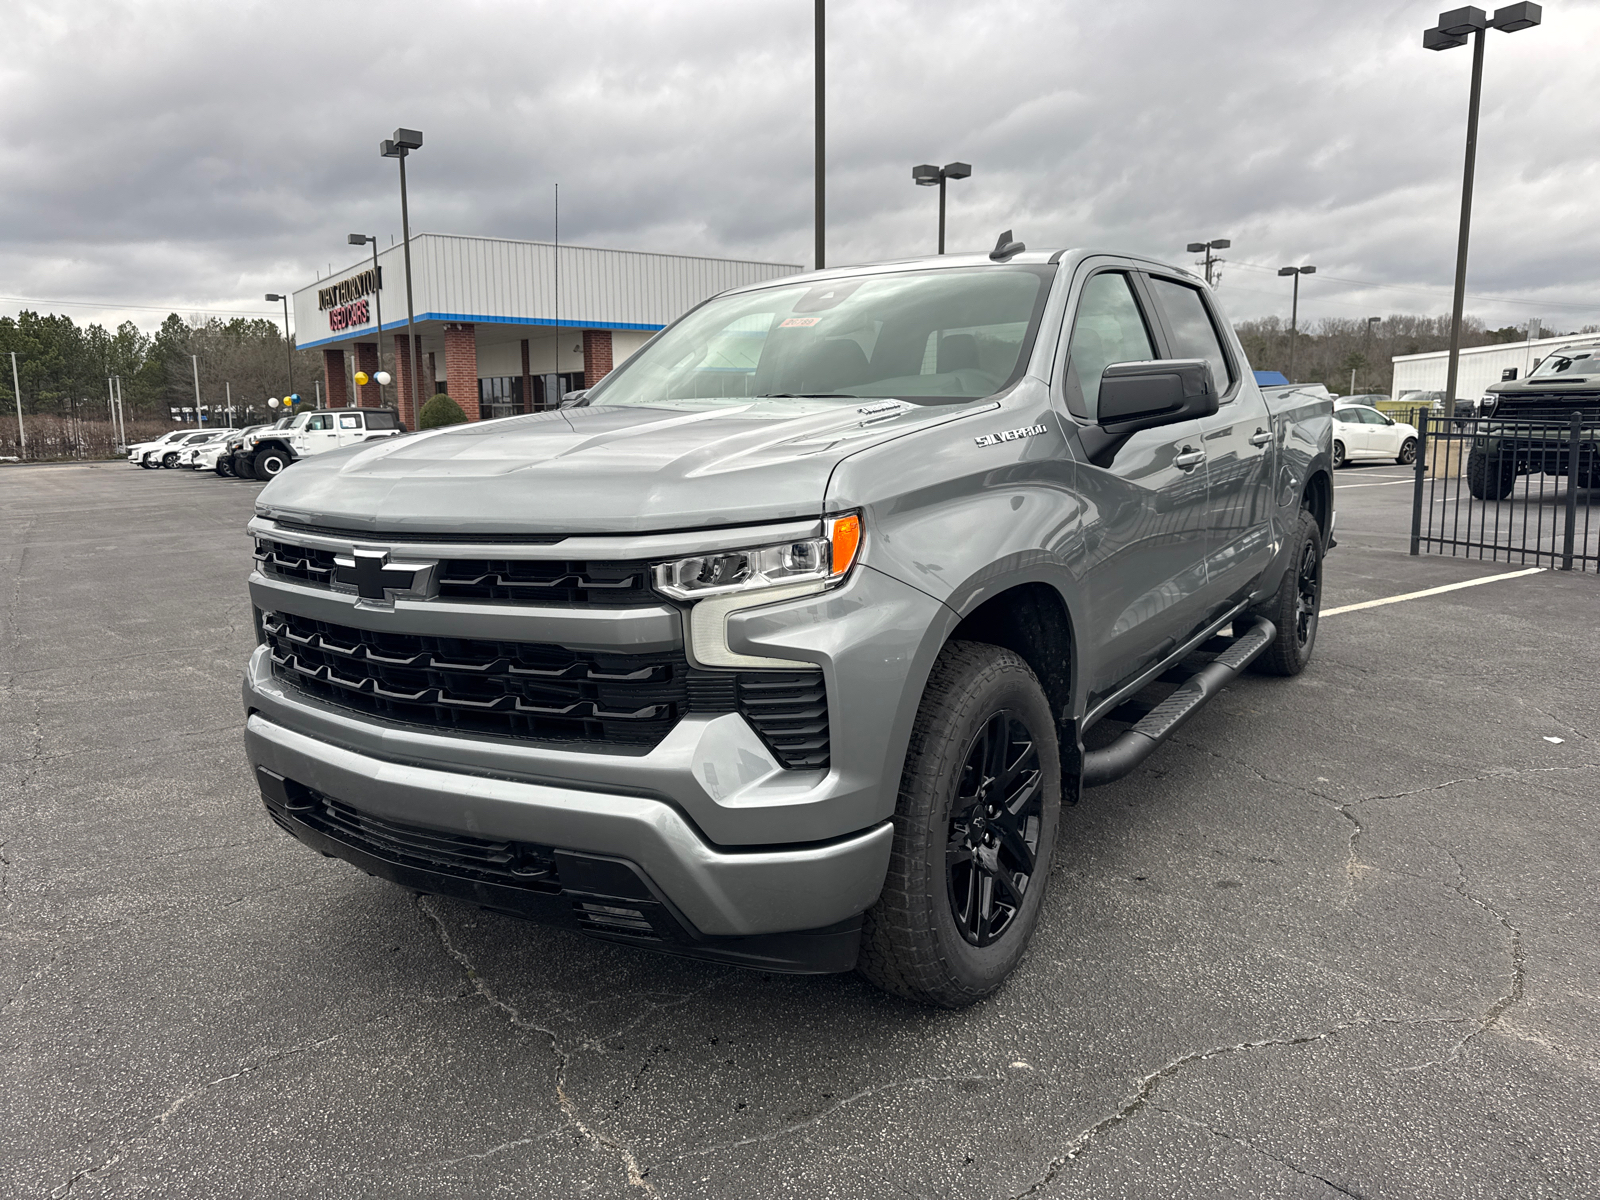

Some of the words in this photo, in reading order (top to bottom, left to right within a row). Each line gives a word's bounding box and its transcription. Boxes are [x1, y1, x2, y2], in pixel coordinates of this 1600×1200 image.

[318, 285, 338, 311] JOHN
[329, 307, 349, 331] USED
[347, 299, 370, 326] CARS
[974, 424, 1048, 448] SILVERADO
